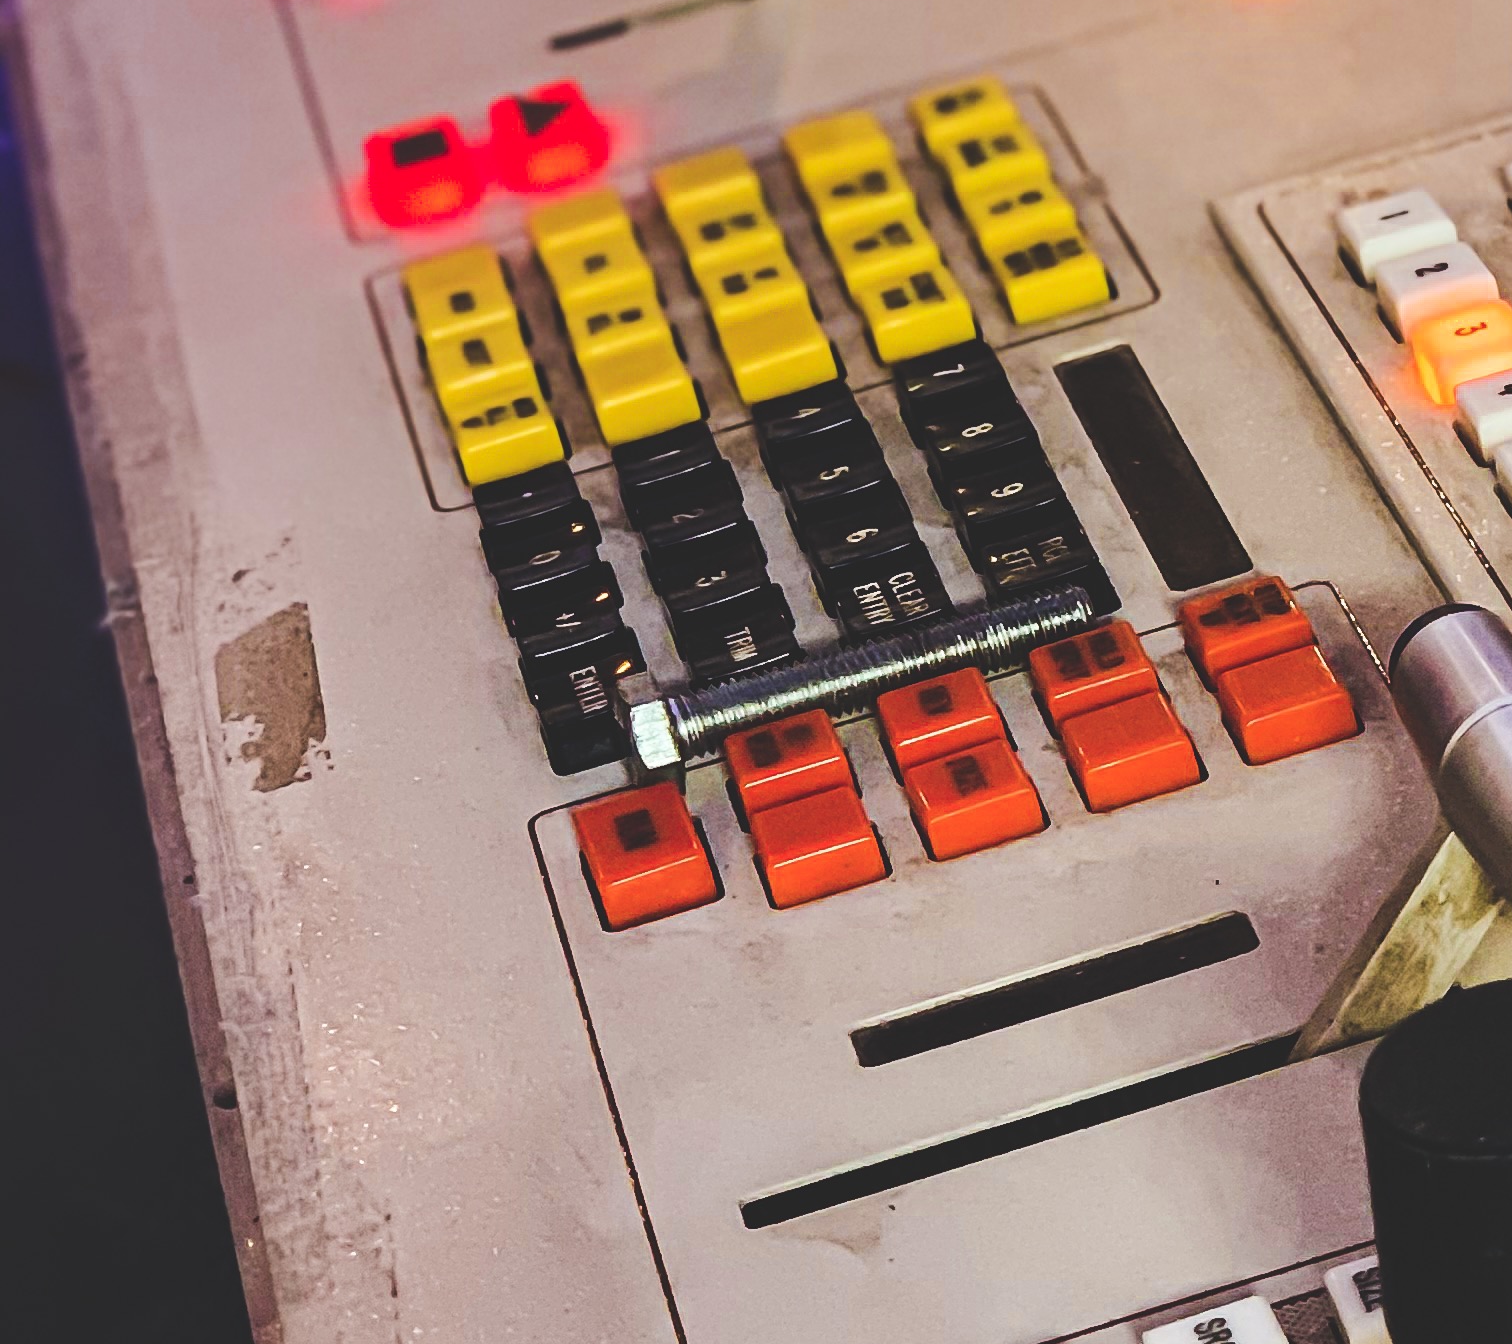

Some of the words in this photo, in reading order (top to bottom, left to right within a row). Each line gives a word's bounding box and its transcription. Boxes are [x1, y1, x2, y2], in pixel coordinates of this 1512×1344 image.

[1415, 263, 1448, 277] 2
[1455, 322, 1487, 337] 3
[933, 364, 964, 376] 7
[962, 423, 993, 437] 8
[820, 466, 848, 480] 5
[991, 483, 1023, 497] 9
[846, 529, 878, 542] 6
[888, 571, 929, 617] CLEAR
[853, 582, 896, 625] ENTRY
[724, 626, 758, 662] TRIM
